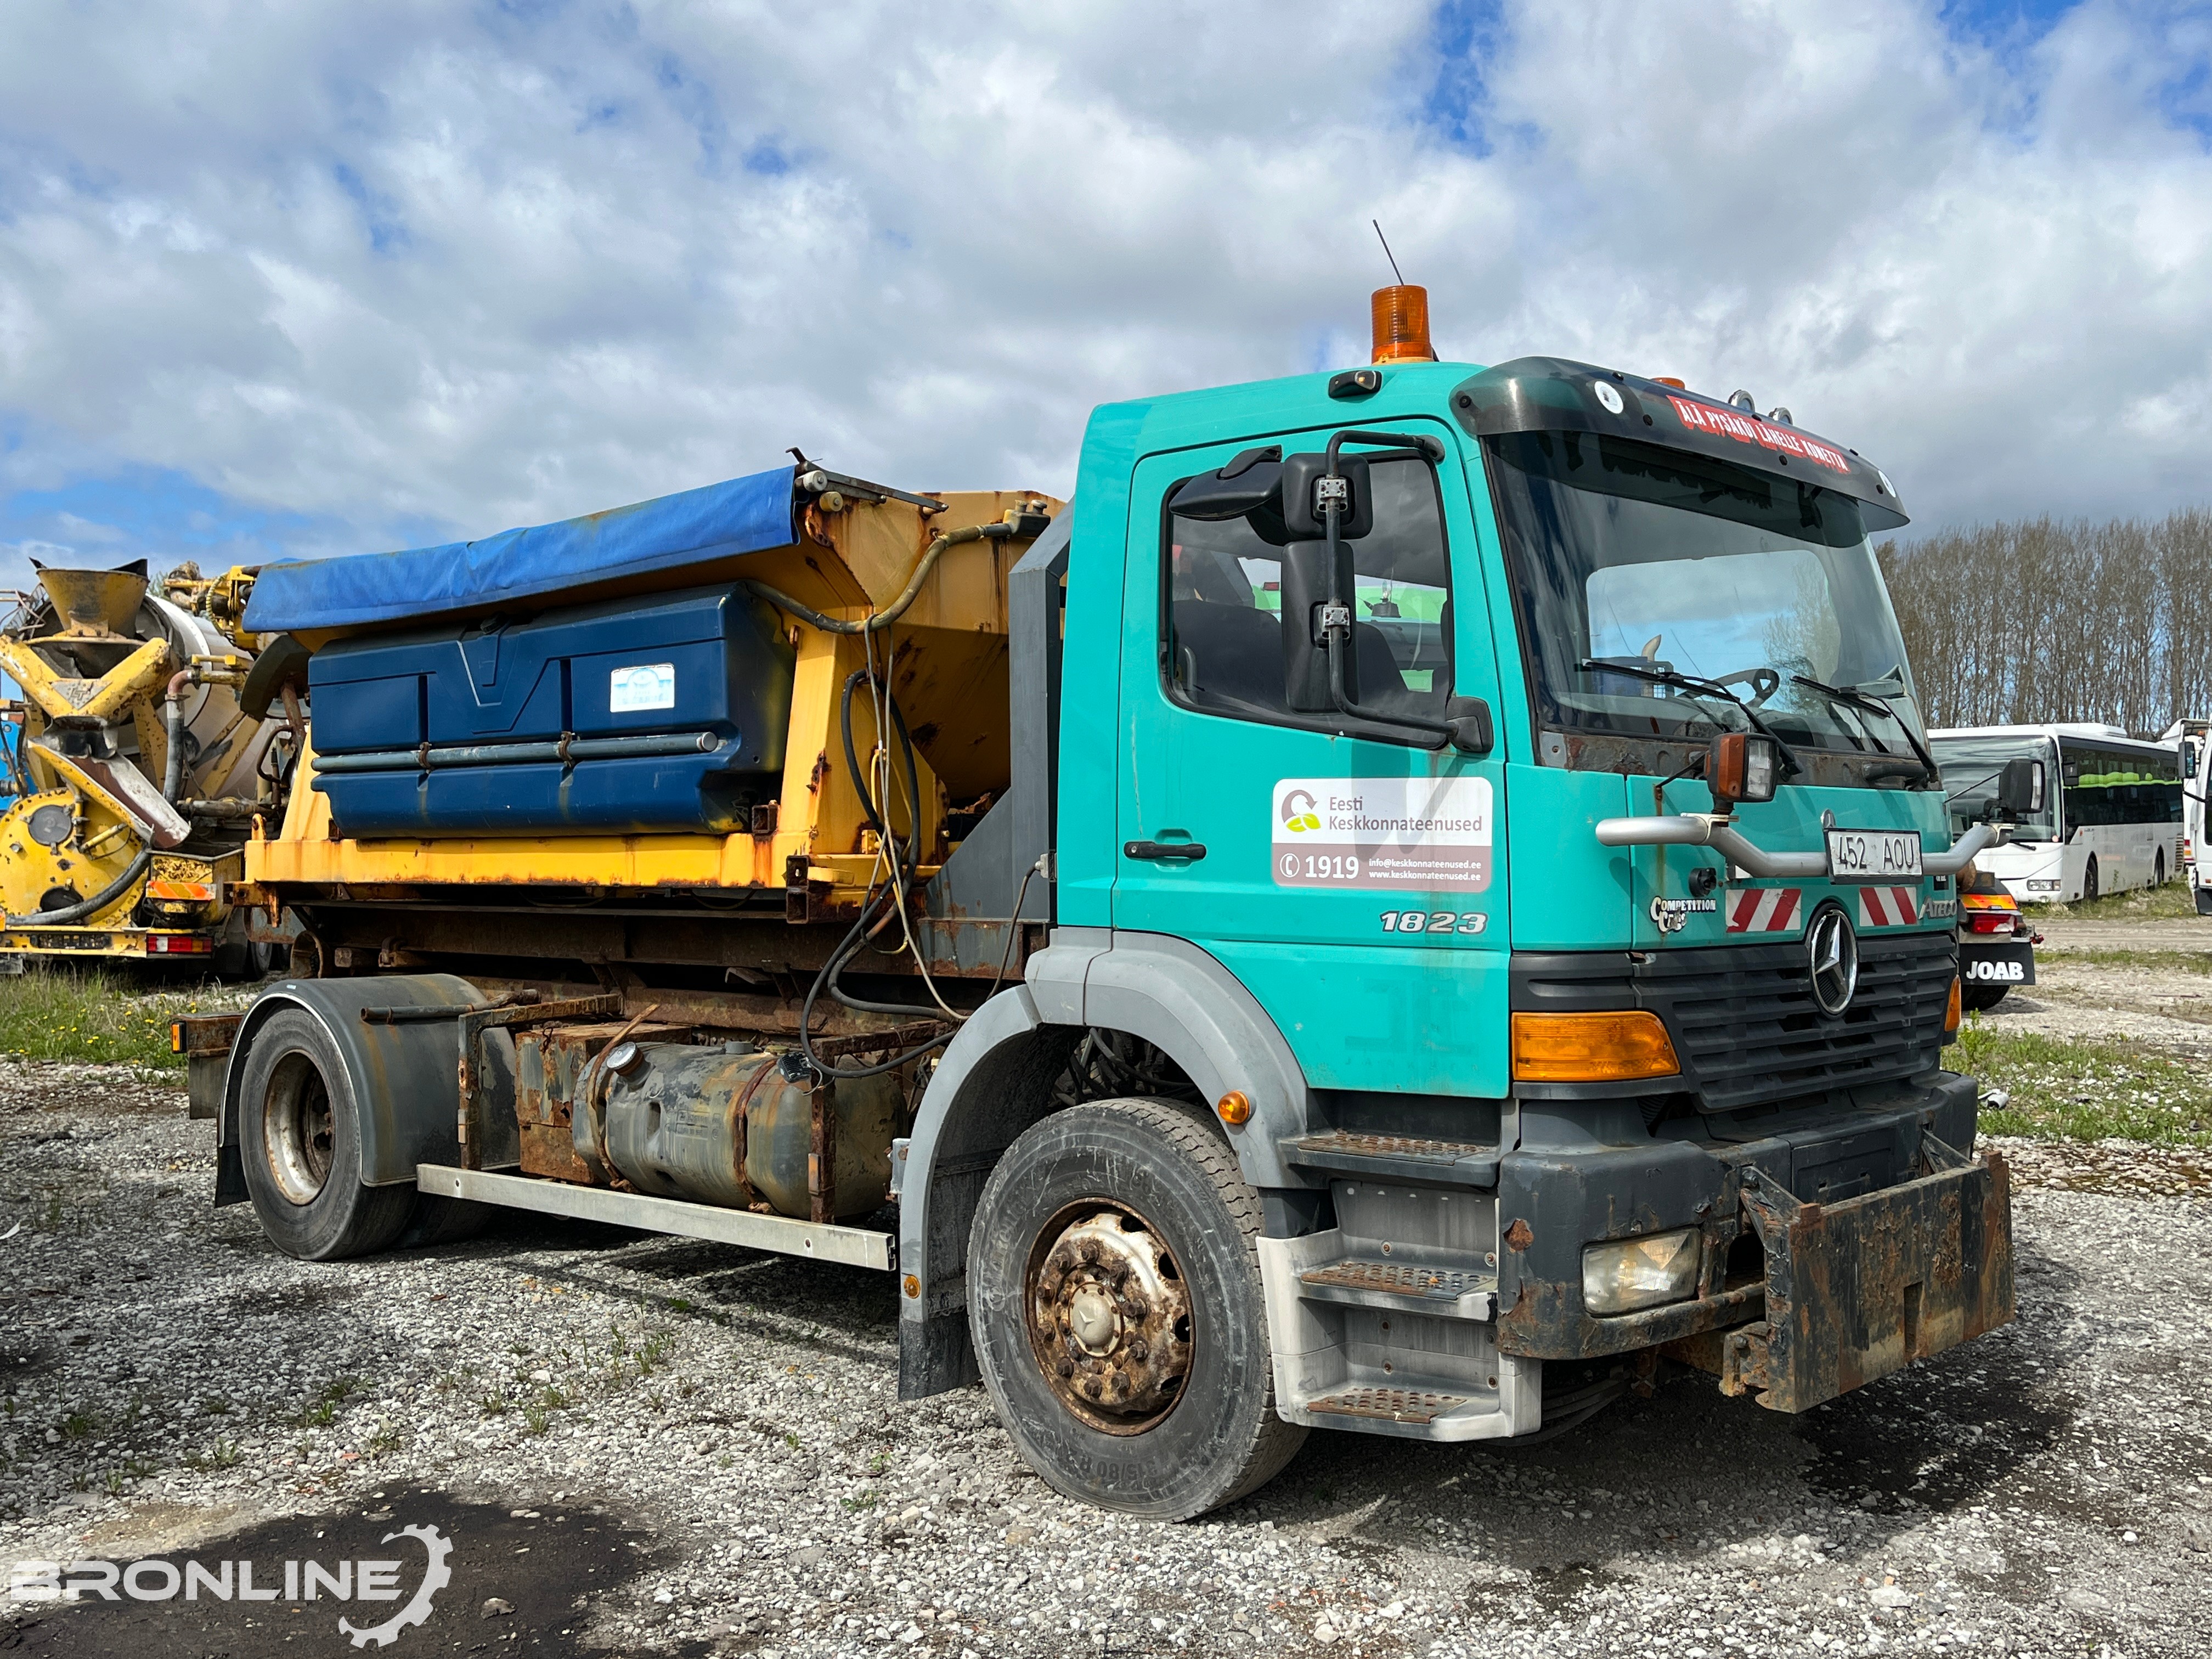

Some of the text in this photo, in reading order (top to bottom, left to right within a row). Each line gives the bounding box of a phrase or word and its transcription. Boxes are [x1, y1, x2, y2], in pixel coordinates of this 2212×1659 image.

[1675, 400, 1707, 426] ÄLÄ
[1705, 410, 1758, 439] PYSÄKÖI
[1329, 795, 1363, 811] Eesti
[1329, 815, 1482, 832] Keskkonnateenused
[1369, 858, 1482, 869] info@keskkonnateenused.ee
[1838, 836, 1914, 870] 452 AOU
[1305, 855, 1359, 879] 1919
[1369, 870, 1481, 881] www.keskkonnateenused.ee
[1650, 896, 1716, 921] COMPETITION
[1380, 910, 1488, 934] 1823
[1966, 961, 2024, 980] JOAB
